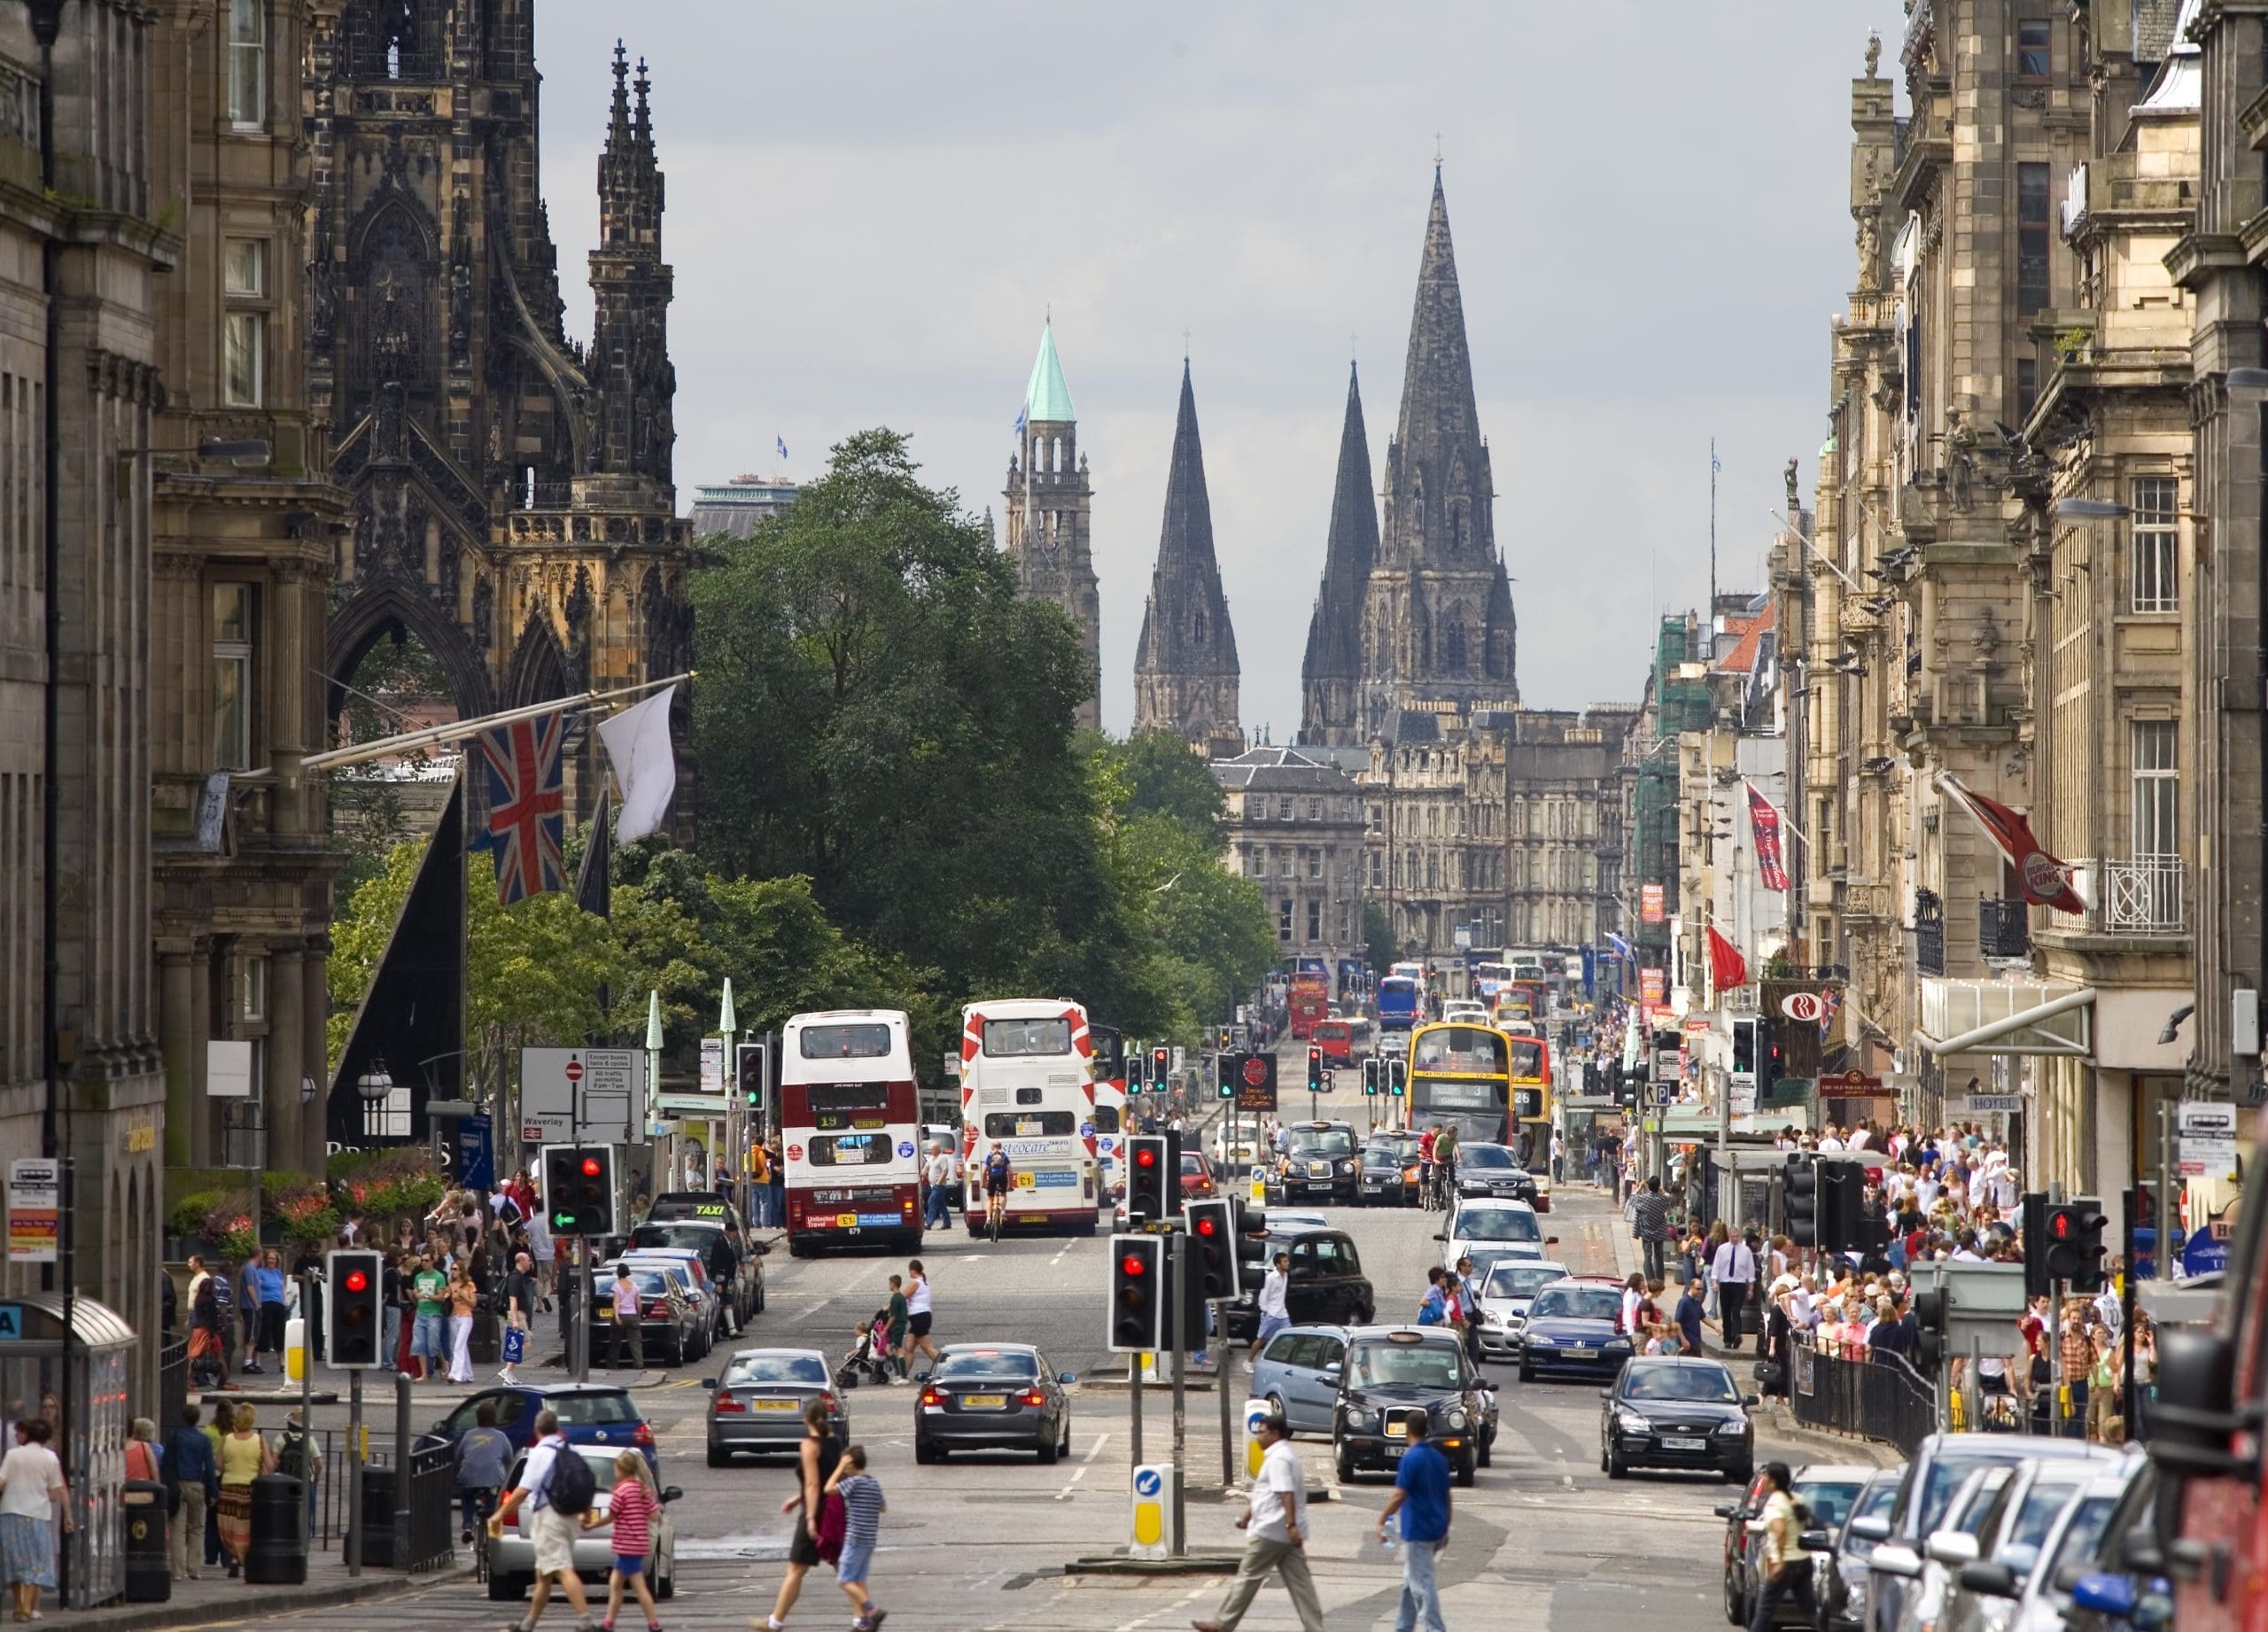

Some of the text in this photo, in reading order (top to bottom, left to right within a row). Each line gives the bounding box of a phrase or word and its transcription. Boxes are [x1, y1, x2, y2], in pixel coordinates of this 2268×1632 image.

[2026, 862, 2055, 877] BURG
[2029, 870, 2060, 887] KING
[1027, 1090, 1041, 1102] 33
[1473, 1086, 1481, 1096] 3
[1658, 1087, 1666, 1102] P
[1974, 1098, 2015, 1110] HOTEL
[524, 1117, 563, 1127] Waverley
[820, 1115, 837, 1127] 19
[1002, 1141, 1050, 1154] steocare
[1020, 1177, 1031, 1186] £1
[696, 1205, 725, 1216] TAXI
[843, 1216, 853, 1225] £1
[849, 1227, 861, 1236] 879
[0, 1310, 16, 1334] A
